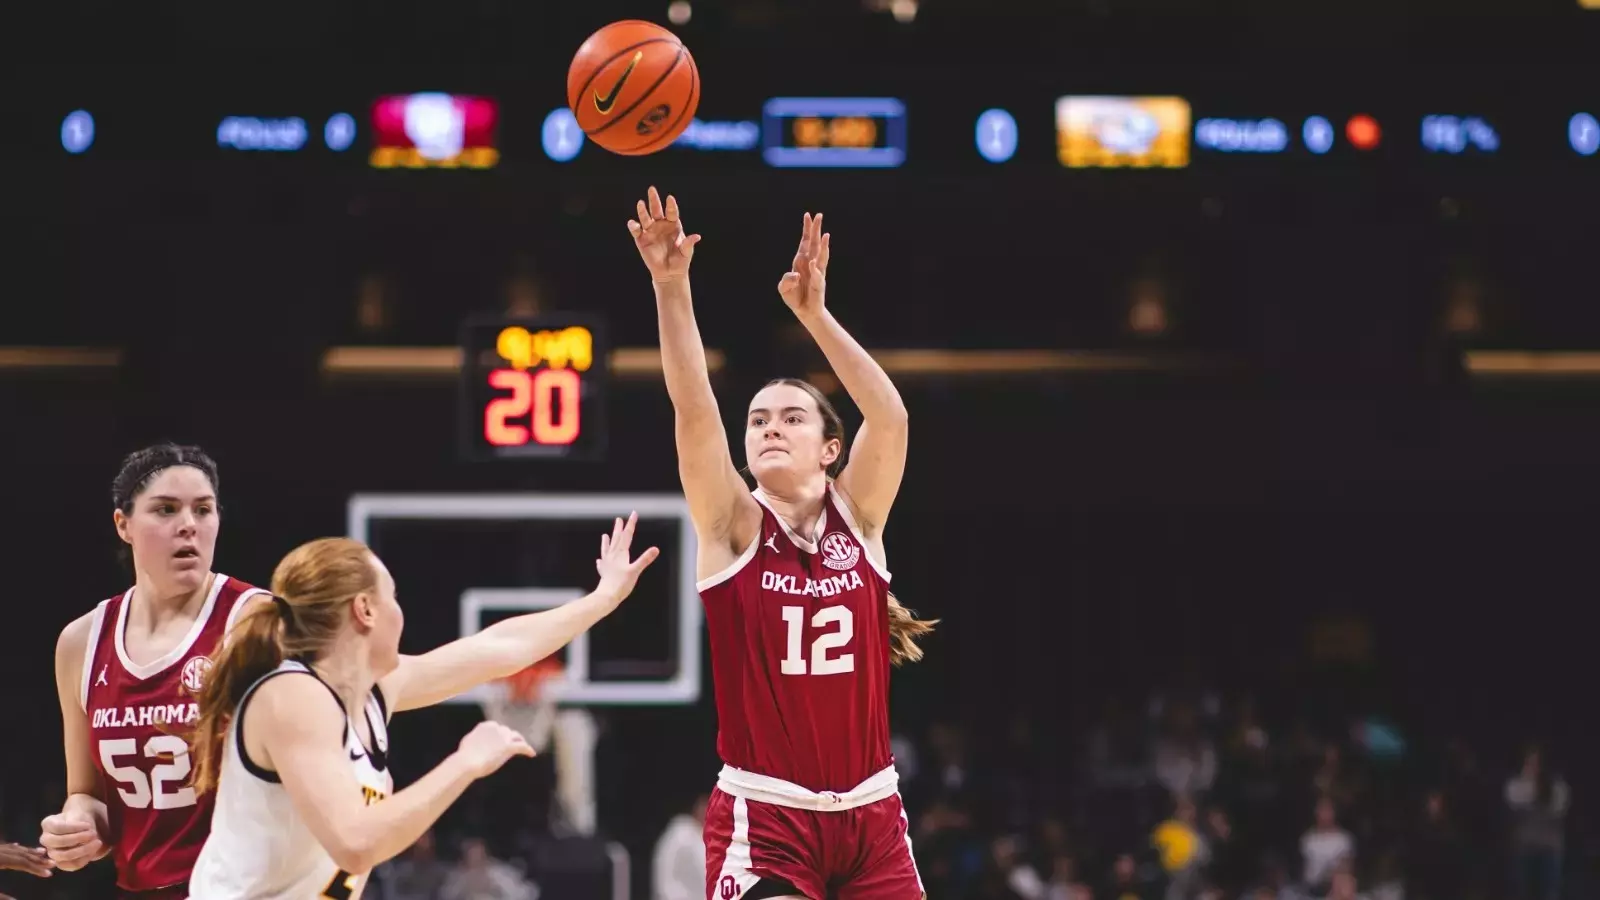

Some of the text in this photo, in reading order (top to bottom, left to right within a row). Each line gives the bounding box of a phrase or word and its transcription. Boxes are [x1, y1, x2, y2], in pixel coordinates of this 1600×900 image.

[484, 368, 581, 446] 20
[824, 534, 852, 560] SEC
[761, 570, 863, 598] OKLAHOMA
[780, 604, 855, 676] 12
[92, 703, 201, 728] OKLAHOMA
[98, 735, 197, 810] 52
